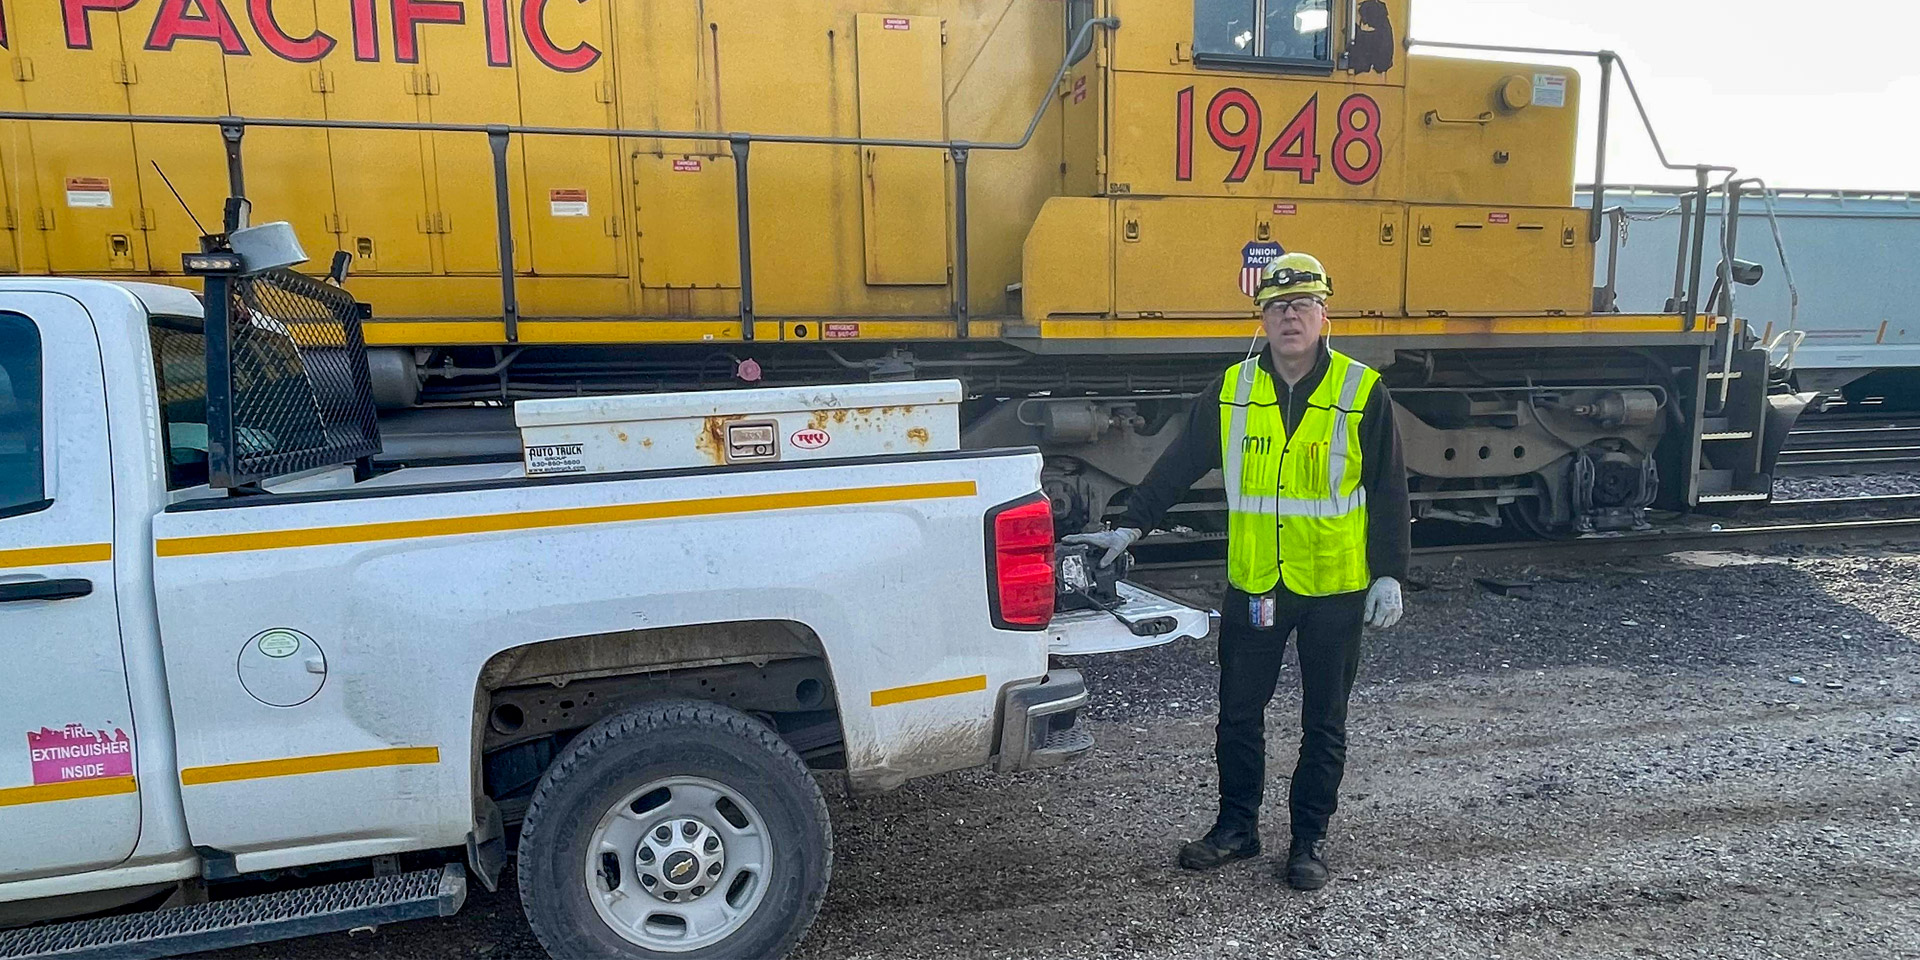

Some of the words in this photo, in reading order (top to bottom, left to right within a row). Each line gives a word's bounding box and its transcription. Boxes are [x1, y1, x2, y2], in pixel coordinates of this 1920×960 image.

[60, 0, 602, 73] PACIFIC
[1175, 85, 1383, 185] 1948
[1249, 248, 1277, 256] UNION
[529, 448, 554, 461] AUTO
[556, 446, 582, 456] TRUCK
[32, 741, 129, 762] EXTINGUISHER
[61, 765, 104, 779] INSIDE
